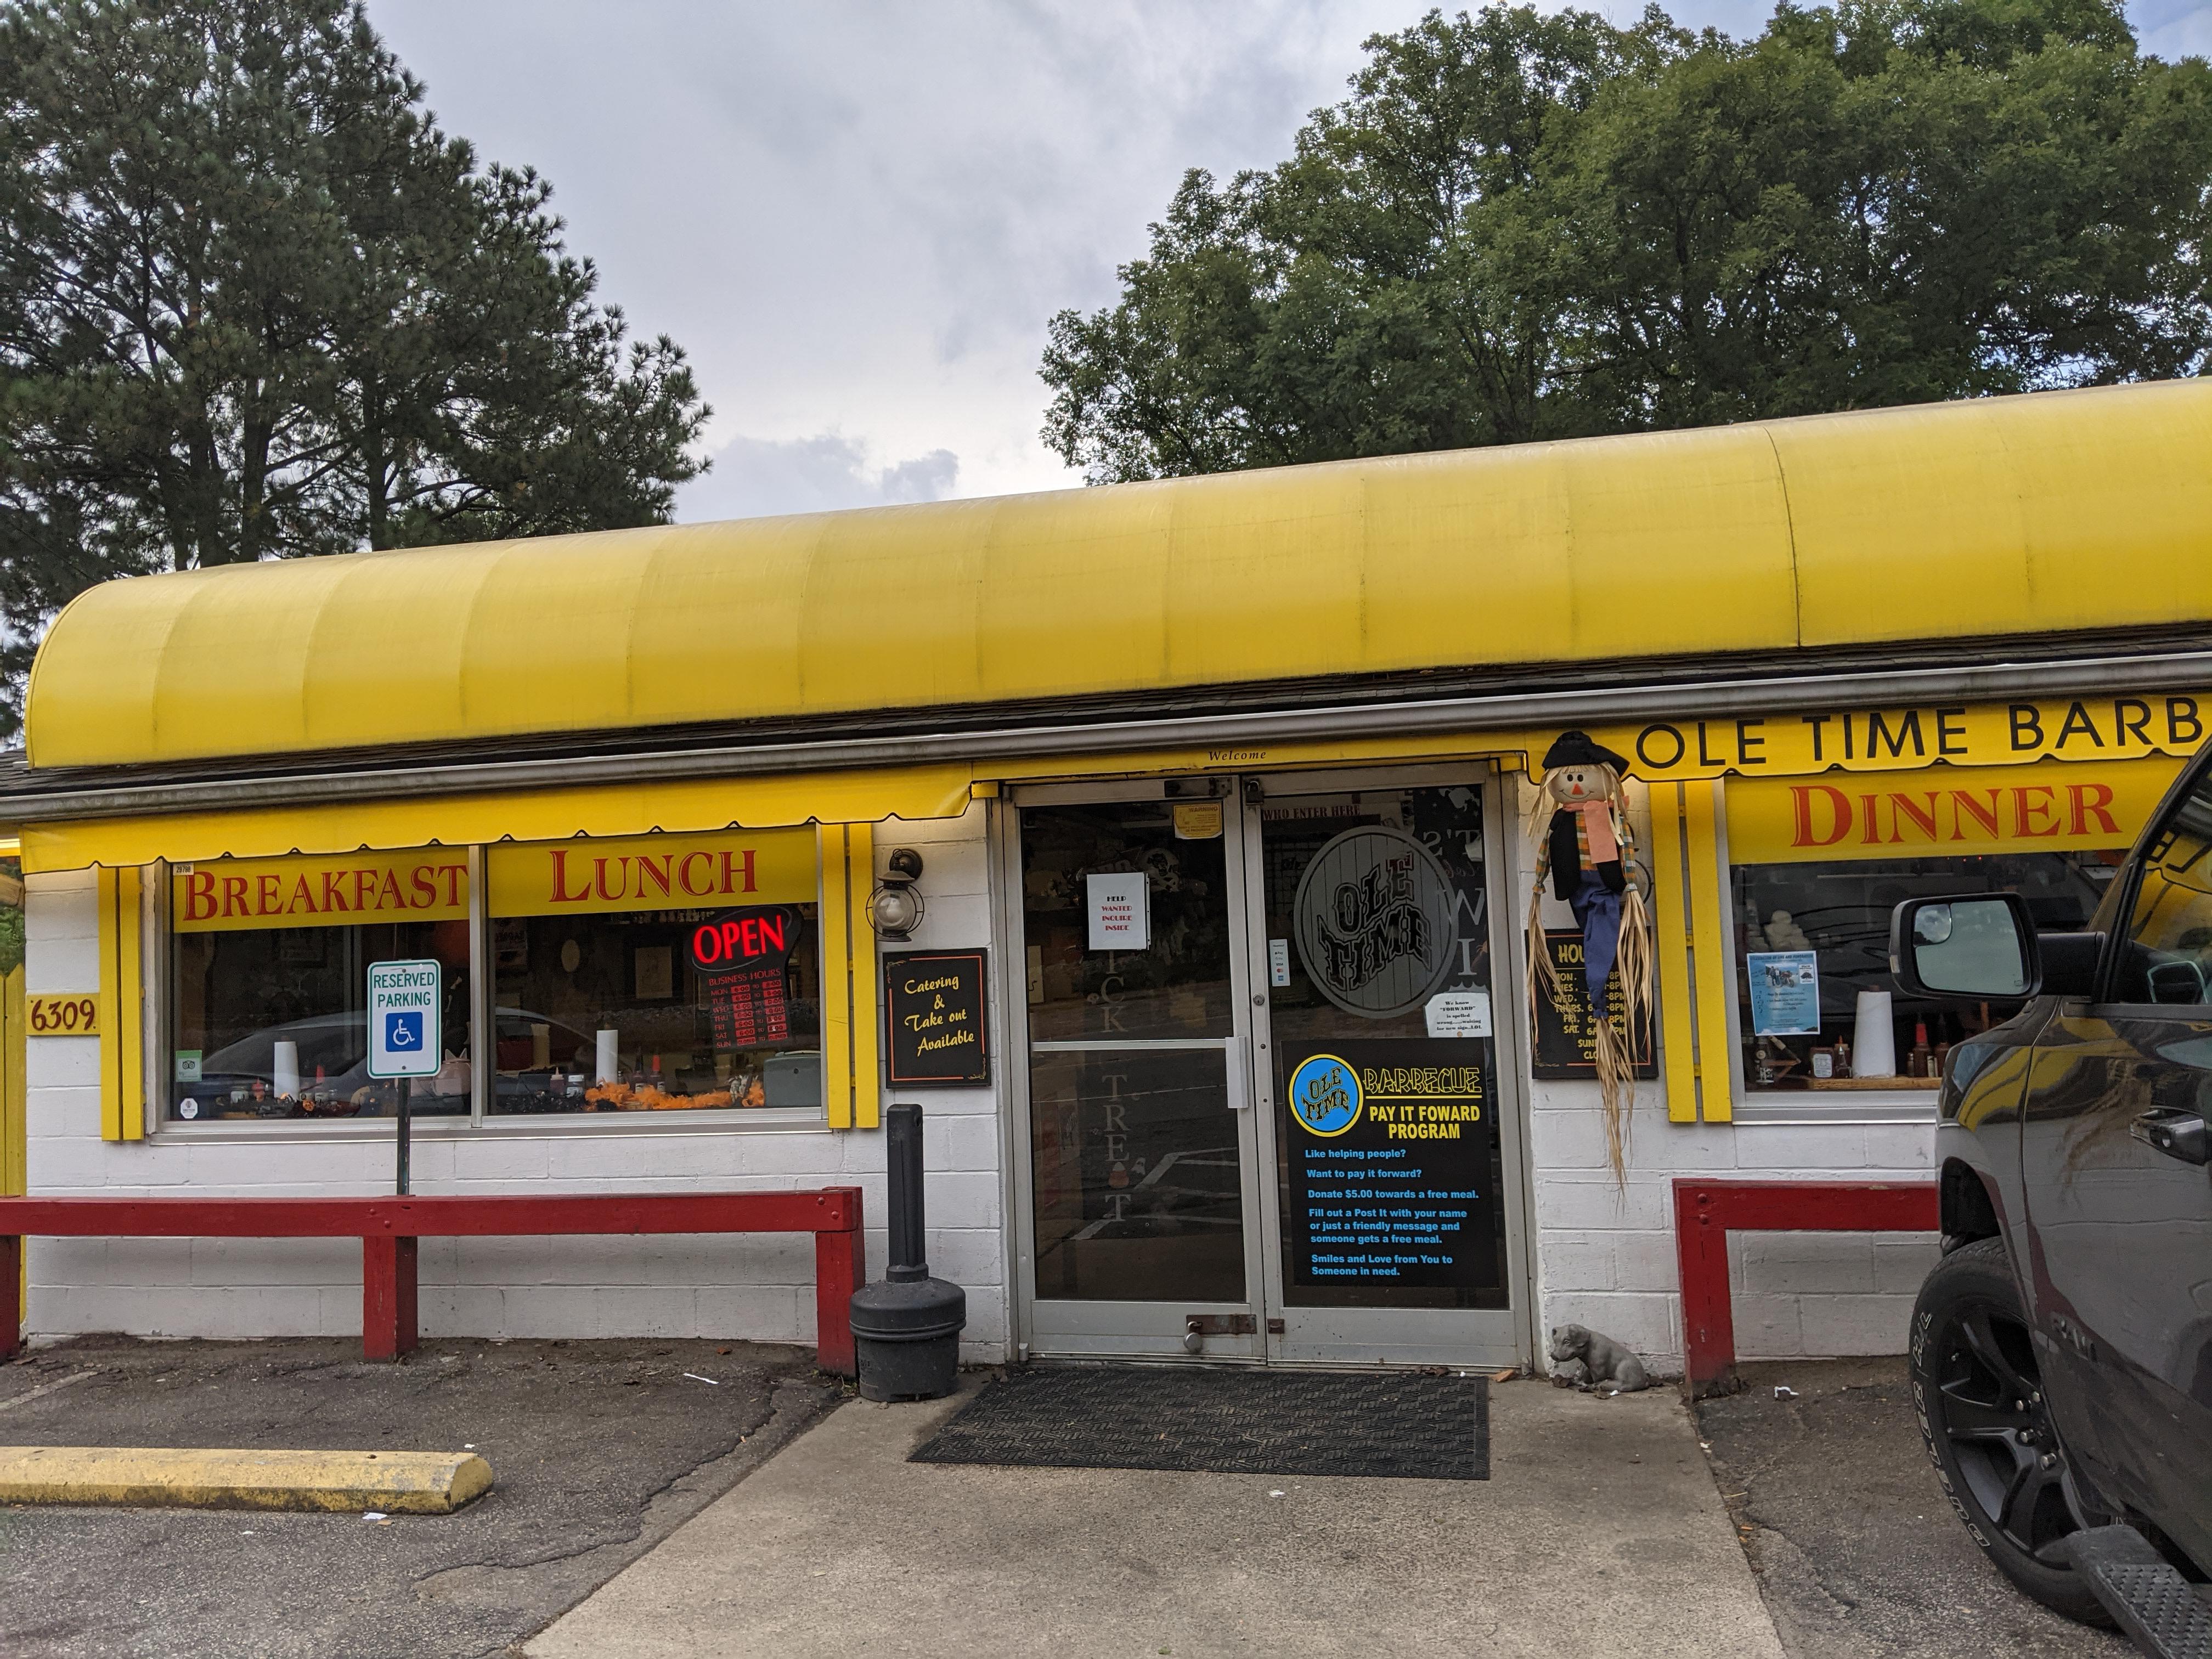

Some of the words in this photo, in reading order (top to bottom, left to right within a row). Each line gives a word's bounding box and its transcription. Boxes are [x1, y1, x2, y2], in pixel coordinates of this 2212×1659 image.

[1636, 719, 1767, 768] OLE
[1802, 708, 1968, 761] TIME
[2009, 697, 2203, 752] BARB
[1209, 751, 1266, 761] Welcome
[1263, 808, 1289, 820] WHO
[1293, 806, 1328, 819] ENTER
[1331, 804, 1361, 817] HERE
[1789, 783, 2123, 847] DINNER
[549, 850, 758, 902] LUNCH
[183, 865, 469, 921] BREAKFAST
[1332, 852, 1414, 935] OLE
[693, 915, 785, 964] OPEN
[1317, 904, 1432, 991] TIME
[1558, 944, 1585, 963] HOU
[374, 972, 435, 989] RESERVED
[709, 973, 747, 986] BUSINESS
[749, 968, 781, 980] HOURS
[904, 976, 959, 995] Catering
[377, 992, 431, 1008] PARKING
[934, 994, 945, 1009] &
[31, 999, 95, 1031] 6309
[904, 1012, 944, 1031] Take
[949, 1008, 967, 1023] out
[917, 1030, 975, 1057] Available
[1308, 1066, 1342, 1100] OLE
[1363, 1068, 1482, 1094] BARBECUE
[1301, 1088, 1350, 1123] TIME
[1369, 1106, 1396, 1122] PAY
[1401, 1107, 1414, 1121] IT
[1419, 1105, 1480, 1122] FOWARD
[1389, 1124, 1460, 1139] PROGRAM
[1305, 1149, 1326, 1158] Like
[1328, 1149, 1364, 1159] helping
[1367, 1149, 1406, 1159] people?
[1306, 1169, 1332, 1178] Want
[1334, 1170, 1345, 1178] to
[1347, 1171, 1365, 1180] pay
[1368, 1169, 1375, 1177] it
[1377, 1169, 1422, 1178] forward?
[1308, 1189, 1343, 1198] Donate
[1345, 1189, 1373, 1198] $5.00
[1375, 1189, 1416, 1198] towards
[1427, 1189, 1448, 1199] free
[1451, 1190, 1479, 1199] meal.
[1308, 1209, 1324, 1217] Fill
[1327, 1209, 1343, 1217] out
[1355, 1209, 1376, 1217] Post
[1379, 1209, 1387, 1217] It
[1389, 1209, 1412, 1217] with
[1414, 1211, 1436, 1219] your
[1322, 1221, 1342, 1232] just
[1352, 1221, 1391, 1232] friendly
[1393, 1223, 1438, 1232] message
[1441, 1222, 1460, 1231] and
[1357, 1234, 1380, 1245] gets
[1391, 1234, 1412, 1243] free
[1414, 1235, 1442, 1243] meal.
[1311, 1254, 1345, 1263] Smiles
[1347, 1255, 1365, 1263] and
[1368, 1255, 1392, 1263] Love
[1394, 1255, 1418, 1263] from
[1420, 1255, 1440, 1263] You
[1442, 1255, 1453, 1263] to
[1312, 1266, 1358, 1275] Someone
[1360, 1267, 1370, 1275] in
[1372, 1267, 1400, 1276] need.
